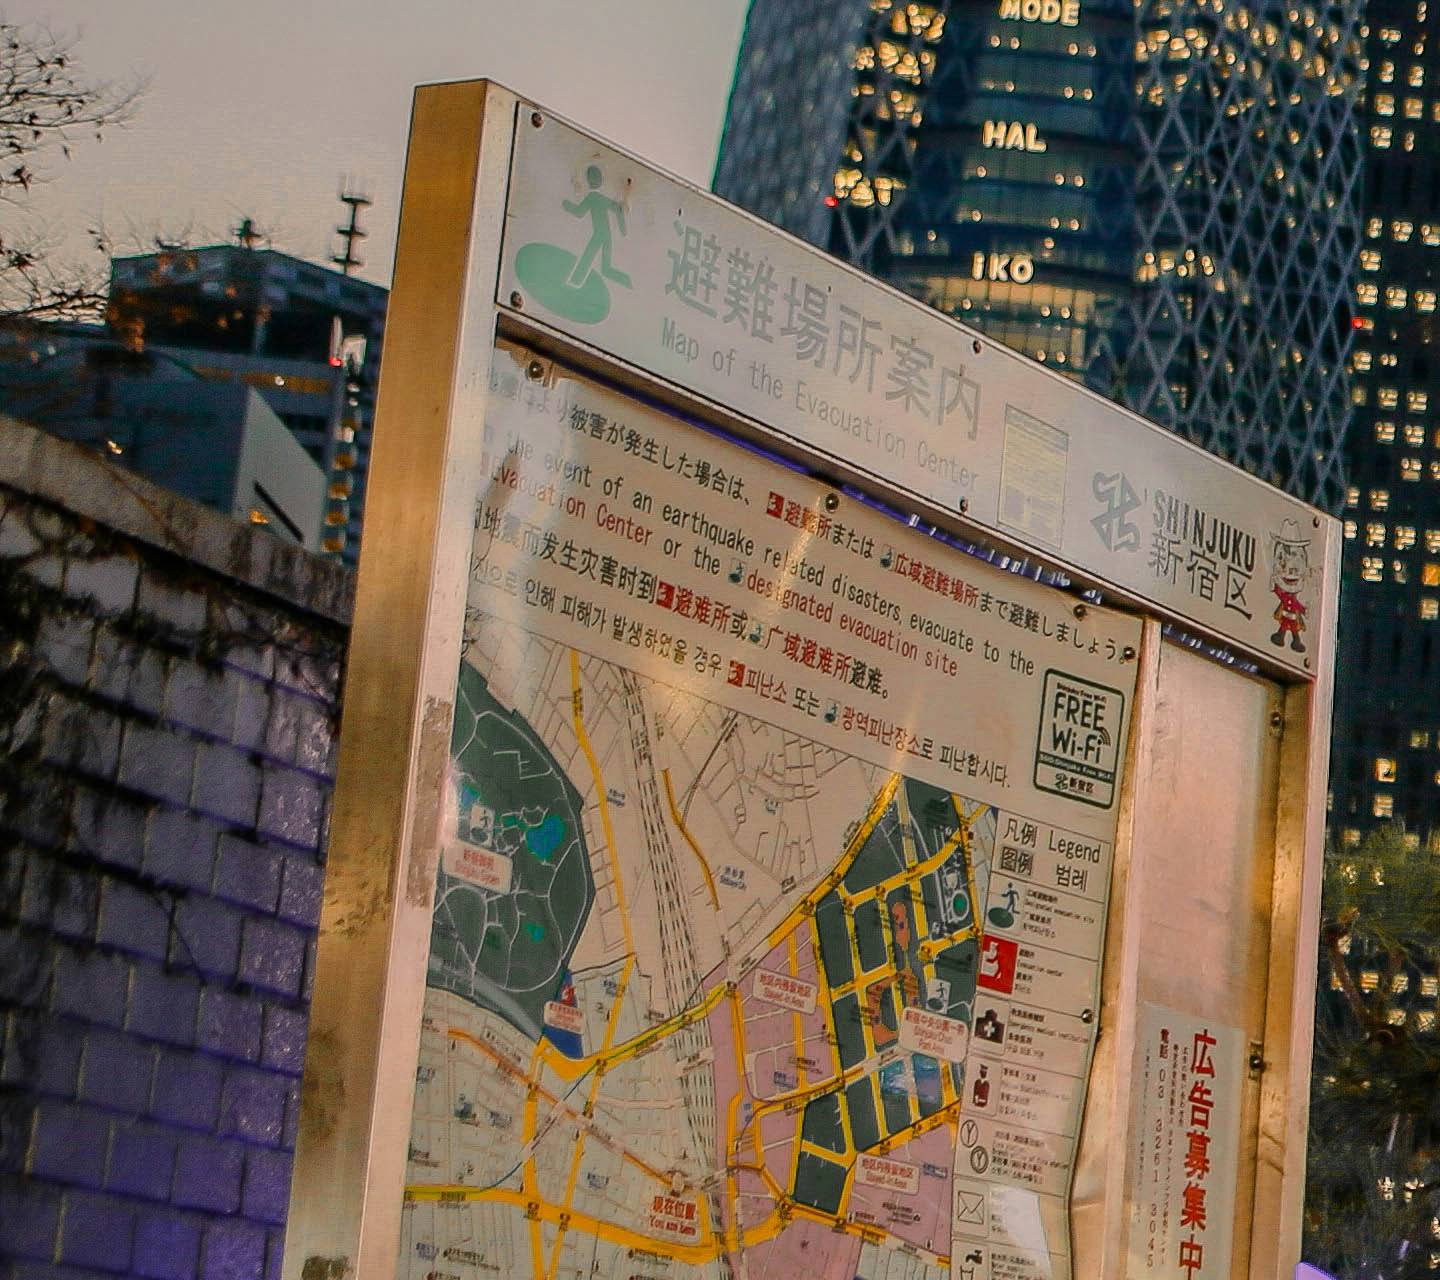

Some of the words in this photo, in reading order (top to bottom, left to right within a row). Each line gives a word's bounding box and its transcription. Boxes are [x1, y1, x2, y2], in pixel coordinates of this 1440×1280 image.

[982, 120, 1048, 154] HAL
[664, 220, 983, 441] 避難場所案内
[662, 318, 700, 361] Map
[712, 348, 737, 377] of
[750, 361, 784, 400] the
[796, 377, 906, 467] Evacuation
[916, 438, 979, 491] Center
[544, 452, 593, 489] event
[602, 476, 624, 500] of
[632, 490, 654, 515] an
[662, 503, 754, 557] earthquake
[763, 544, 826, 587] related
[909, 614, 974, 653] evacuate
[983, 640, 1000, 663] to
[1009, 650, 1035, 676] the
[1152, 488, 1257, 571] SHINJUKU
[596, 503, 653, 546] Center
[663, 537, 682, 559] or
[693, 546, 721, 575] the
[746, 569, 833, 625] designated
[840, 609, 918, 662] evacuation
[925, 648, 958, 677] site
[1150, 532, 1253, 621] 新宿区
[525, 578, 556, 612] 인해
[561, 593, 608, 634] 피해가
[694, 646, 722, 675] 경우
[745, 667, 788, 704] 피난소
[793, 690, 821, 718] 또는
[841, 709, 934, 761] 광역피난장소로
[940, 743, 1012, 789] 피난합시다.
[1054, 691, 1106, 732] FREE
[1052, 722, 1104, 764] Wi-Fi
[1003, 817, 1038, 848] 凡例
[1048, 829, 1101, 863] Legend
[1055, 863, 1088, 893] 범례
